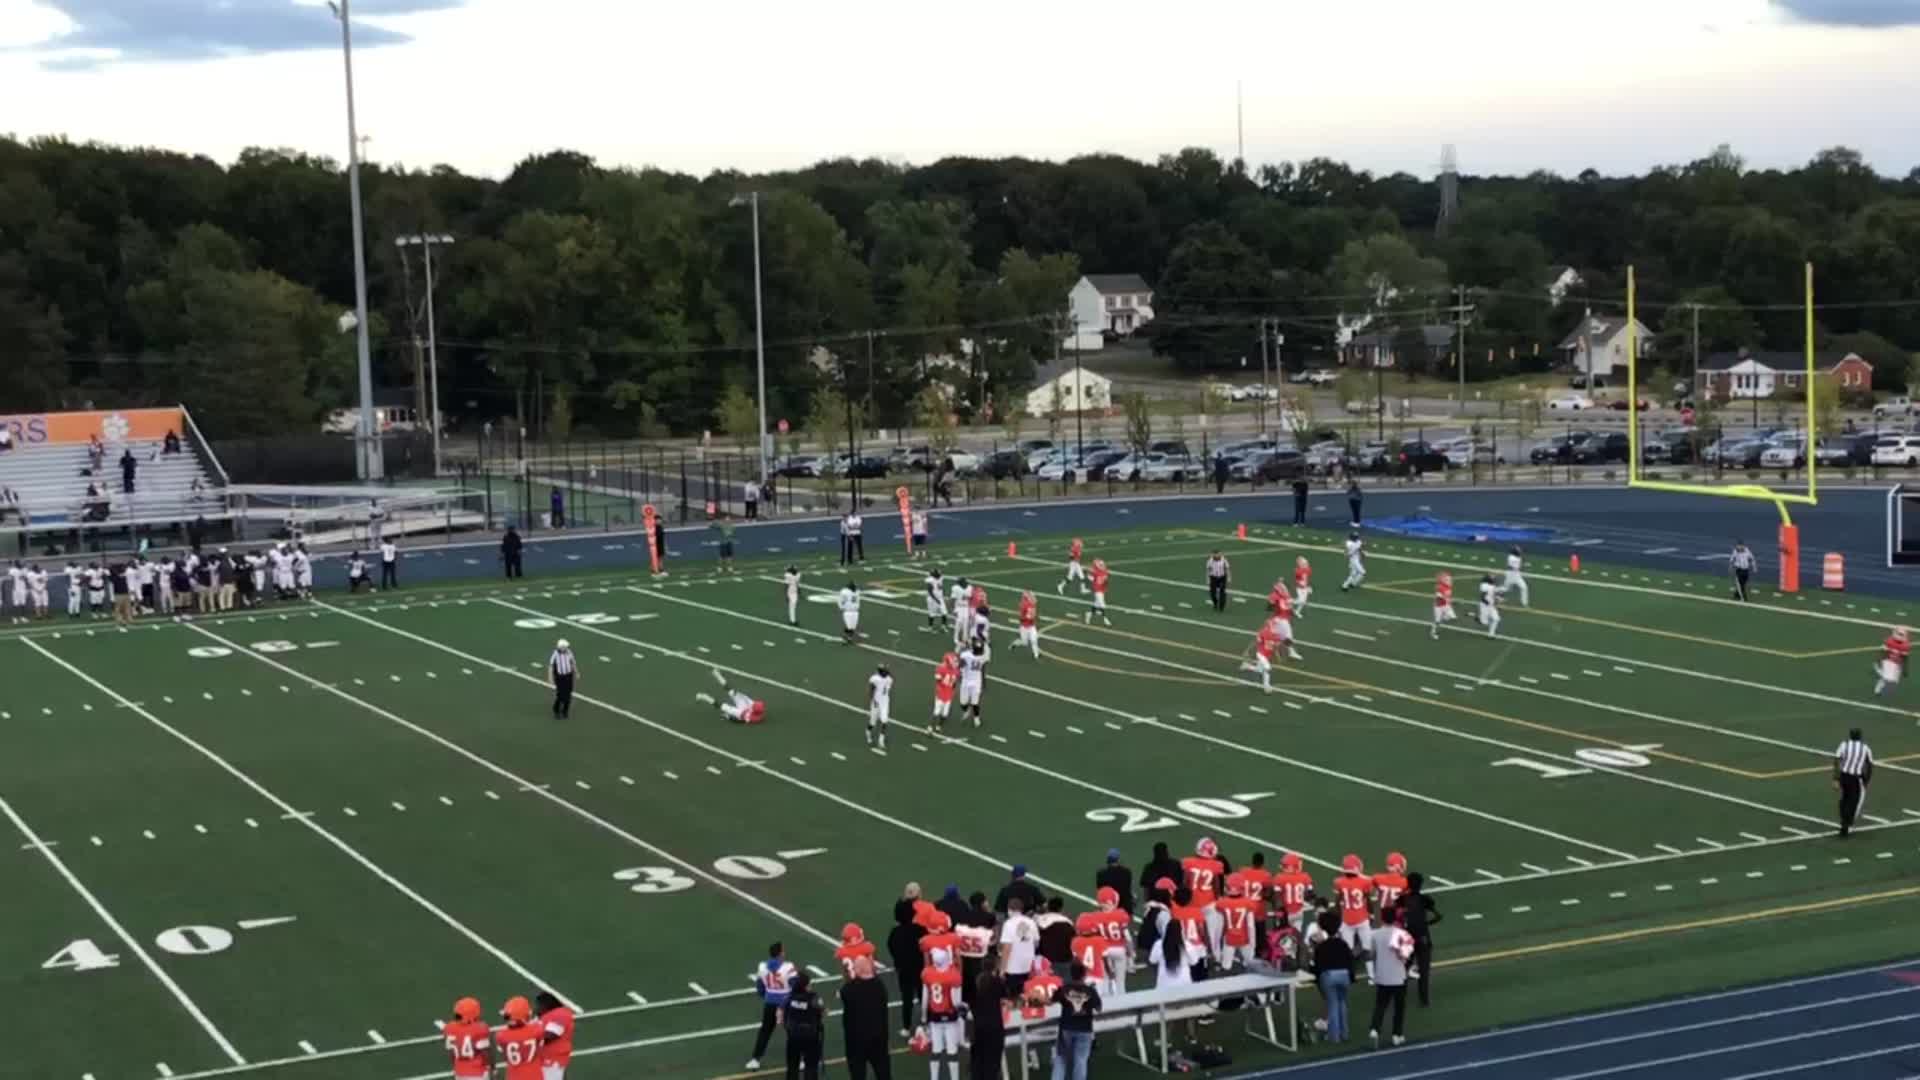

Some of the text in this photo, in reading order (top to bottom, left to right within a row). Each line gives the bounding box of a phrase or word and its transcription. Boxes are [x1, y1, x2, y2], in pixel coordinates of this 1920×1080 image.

[1190, 867, 1213, 891] 72
[1244, 879, 1263, 901] 12
[1342, 887, 1364, 910] 13
[1225, 907, 1247, 929] 17
[1099, 921, 1121, 941] 16
[1083, 945, 1095, 969] 4
[930, 983, 943, 1004] 8
[445, 1035, 475, 1058] 54
[506, 1038, 537, 1066] 67
